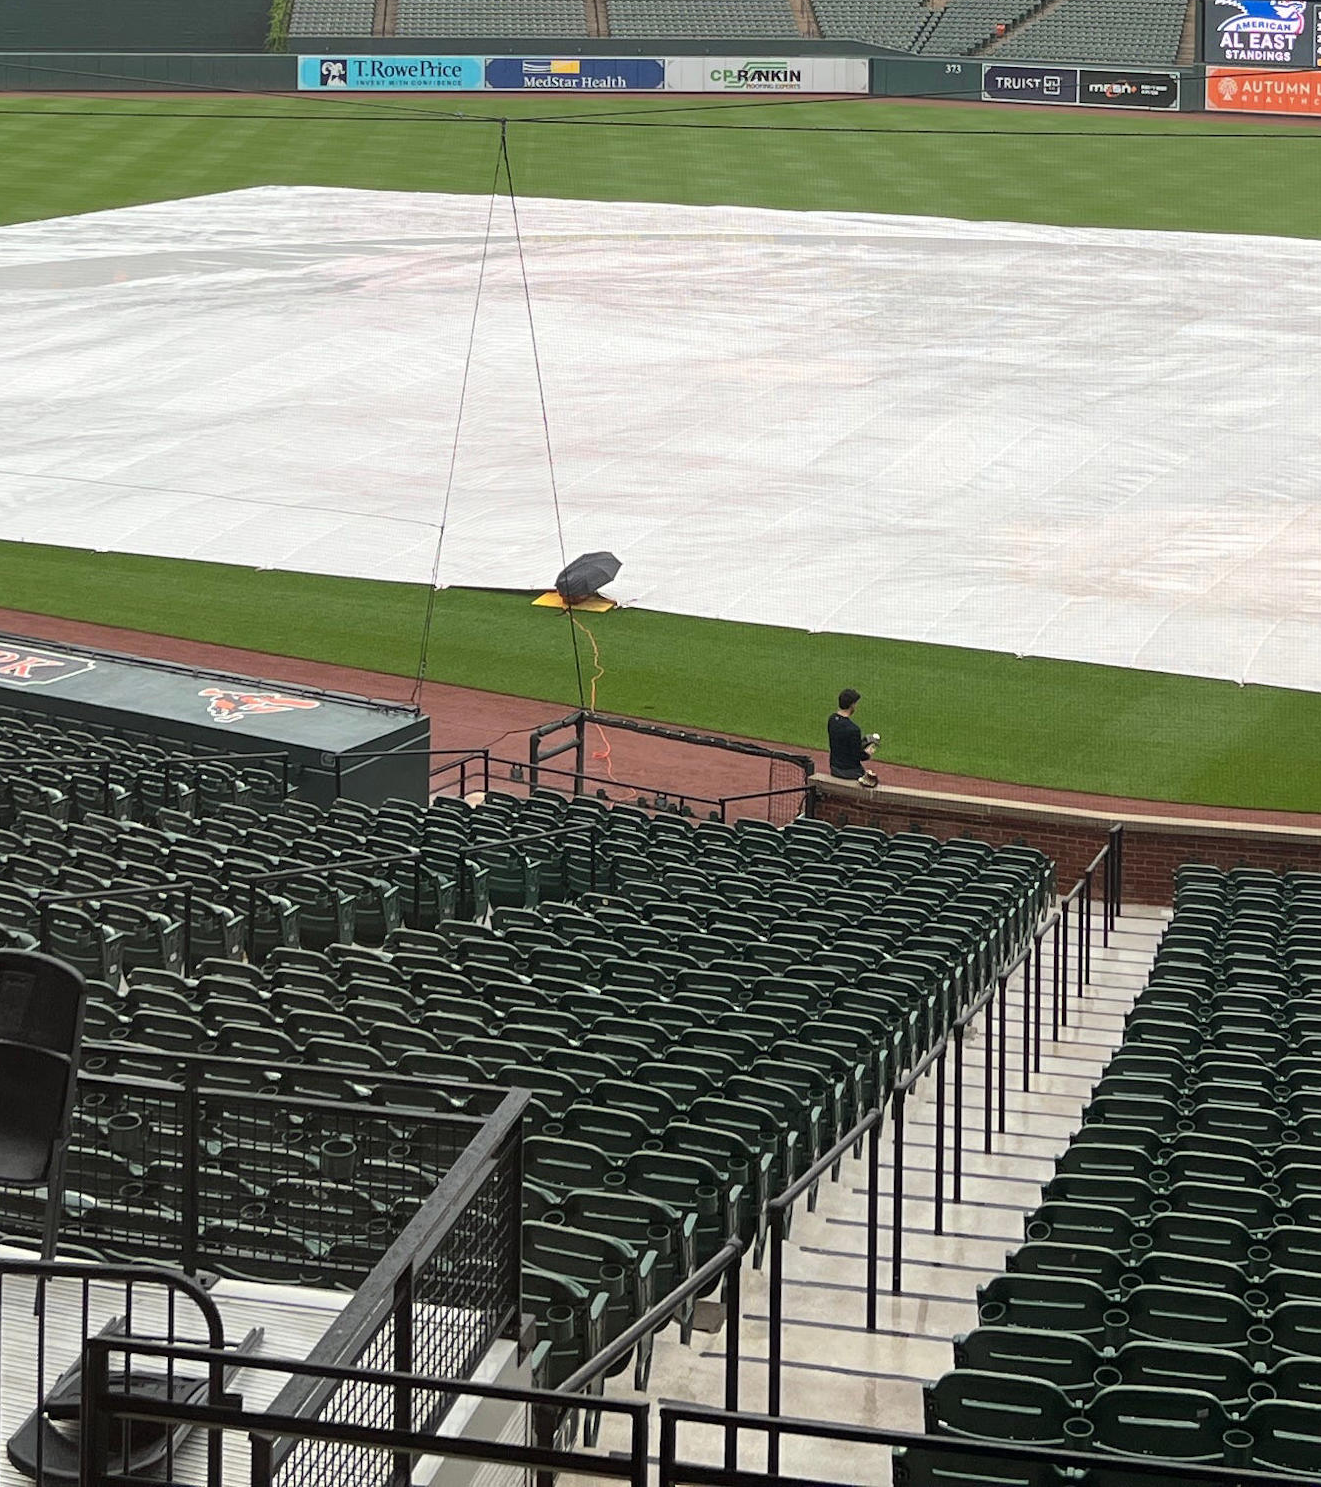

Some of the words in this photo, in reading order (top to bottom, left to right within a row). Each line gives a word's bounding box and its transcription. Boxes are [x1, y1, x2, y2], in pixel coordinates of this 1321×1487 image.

[1235, 20, 1292, 32] AMERICAN
[1219, 33, 1246, 49] AL
[1249, 34, 1297, 51] EAST
[1225, 50, 1291, 62] STANDINGS
[420, 60, 463, 78] Price
[945, 64, 962, 75] 373
[523, 75, 578, 88] MedStar
[581, 76, 626, 89] Health
[995, 76, 1042, 90] TRUIST
[1242, 80, 1311, 96] AUTUMN
